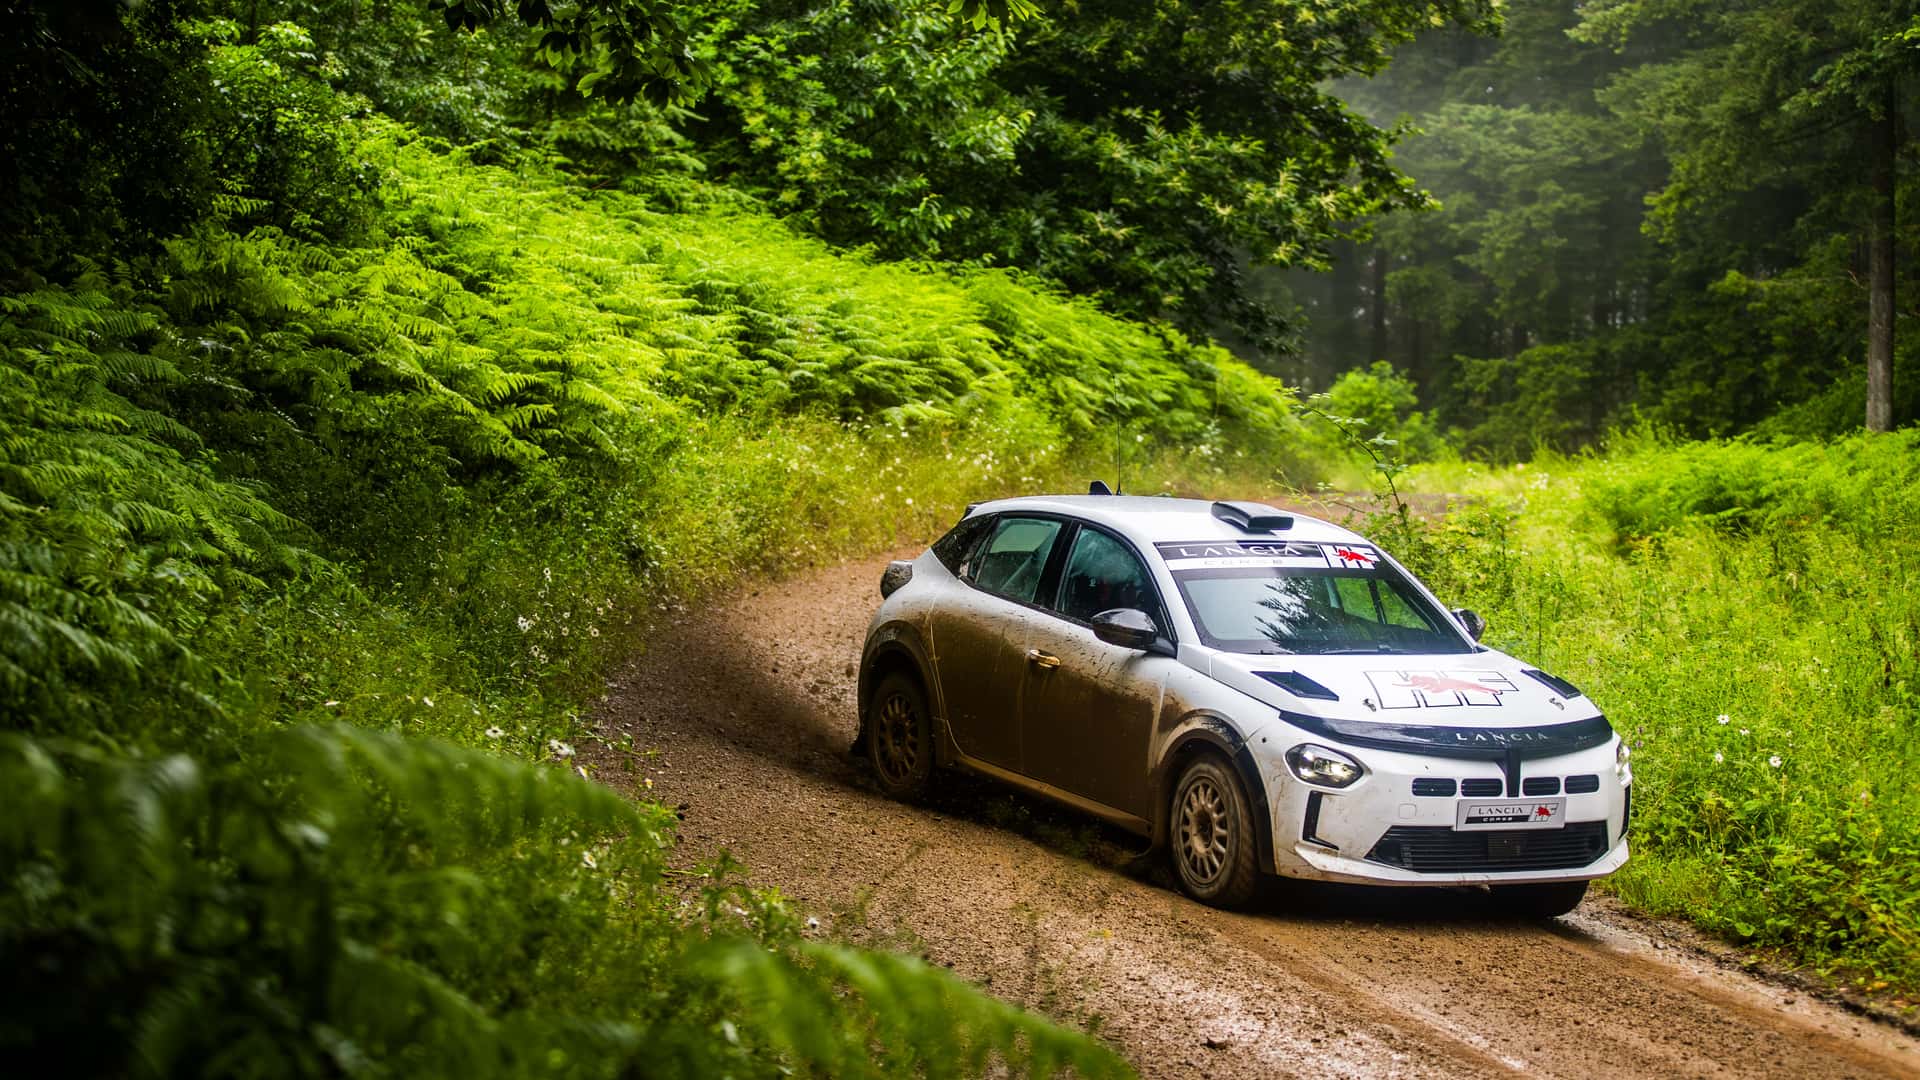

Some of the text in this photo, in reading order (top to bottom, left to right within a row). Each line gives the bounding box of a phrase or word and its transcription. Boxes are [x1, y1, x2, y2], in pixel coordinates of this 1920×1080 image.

[1179, 545, 1303, 557] LANCIA
[1455, 732, 1549, 743] LANCIA
[1478, 807, 1524, 815] LANCIA
